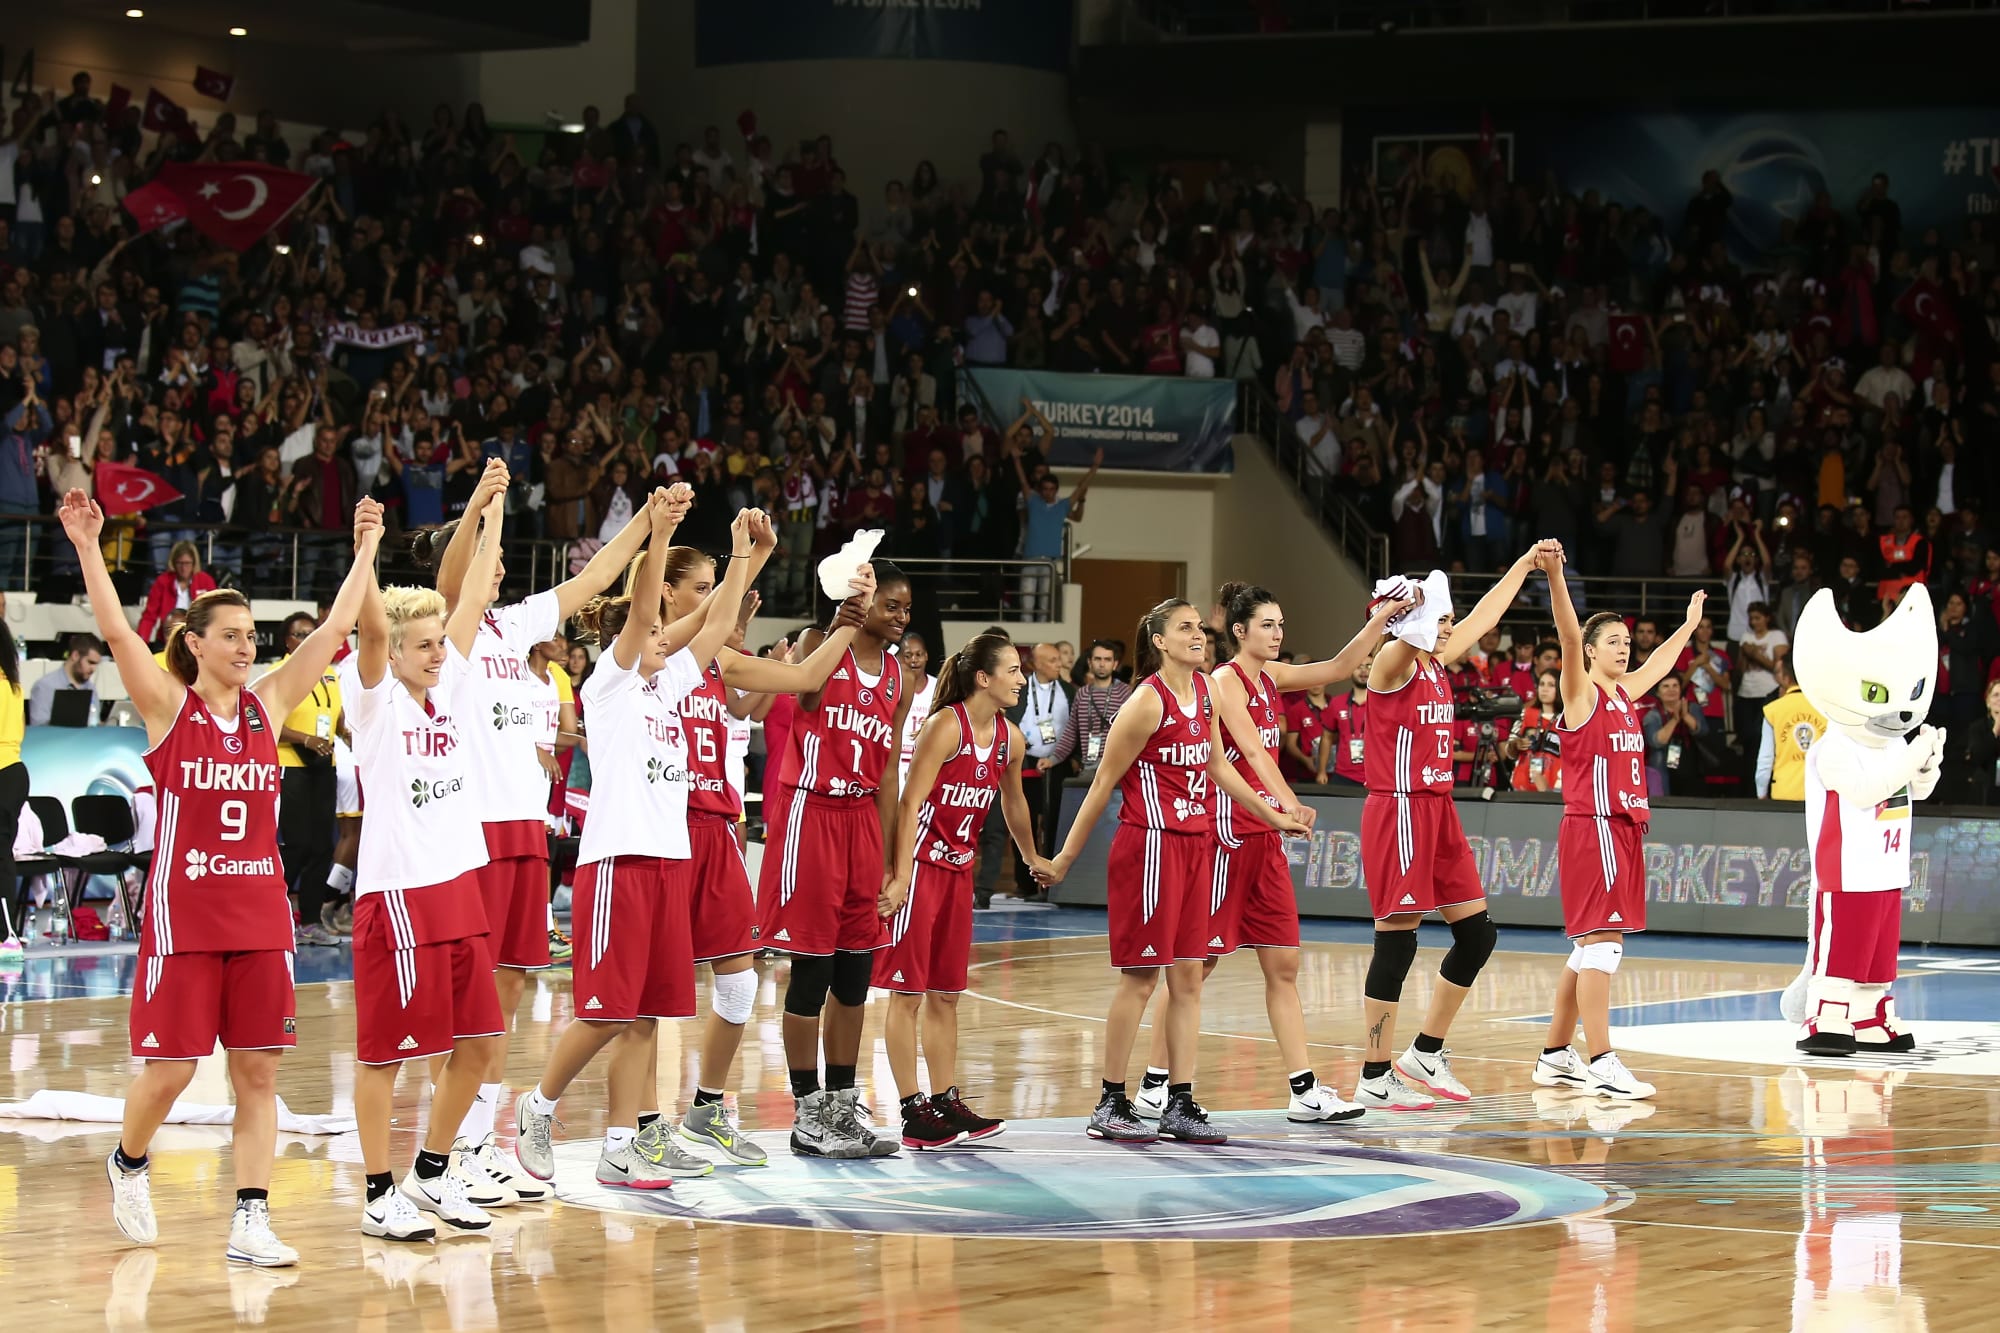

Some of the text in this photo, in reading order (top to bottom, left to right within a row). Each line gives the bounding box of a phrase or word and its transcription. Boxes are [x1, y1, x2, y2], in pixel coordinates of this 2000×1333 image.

[1126, 430, 1145, 441] FOR
[1145, 431, 1179, 443] WOMEN
[693, 726, 717, 762] 15
[850, 739, 863, 775] 1
[1186, 770, 1207, 800] 14
[1631, 757, 1641, 786] 8
[220, 800, 248, 842] 9
[956, 814, 974, 842] 4
[1883, 828, 1902, 854] 14
[209, 854, 275, 876] Garanti
